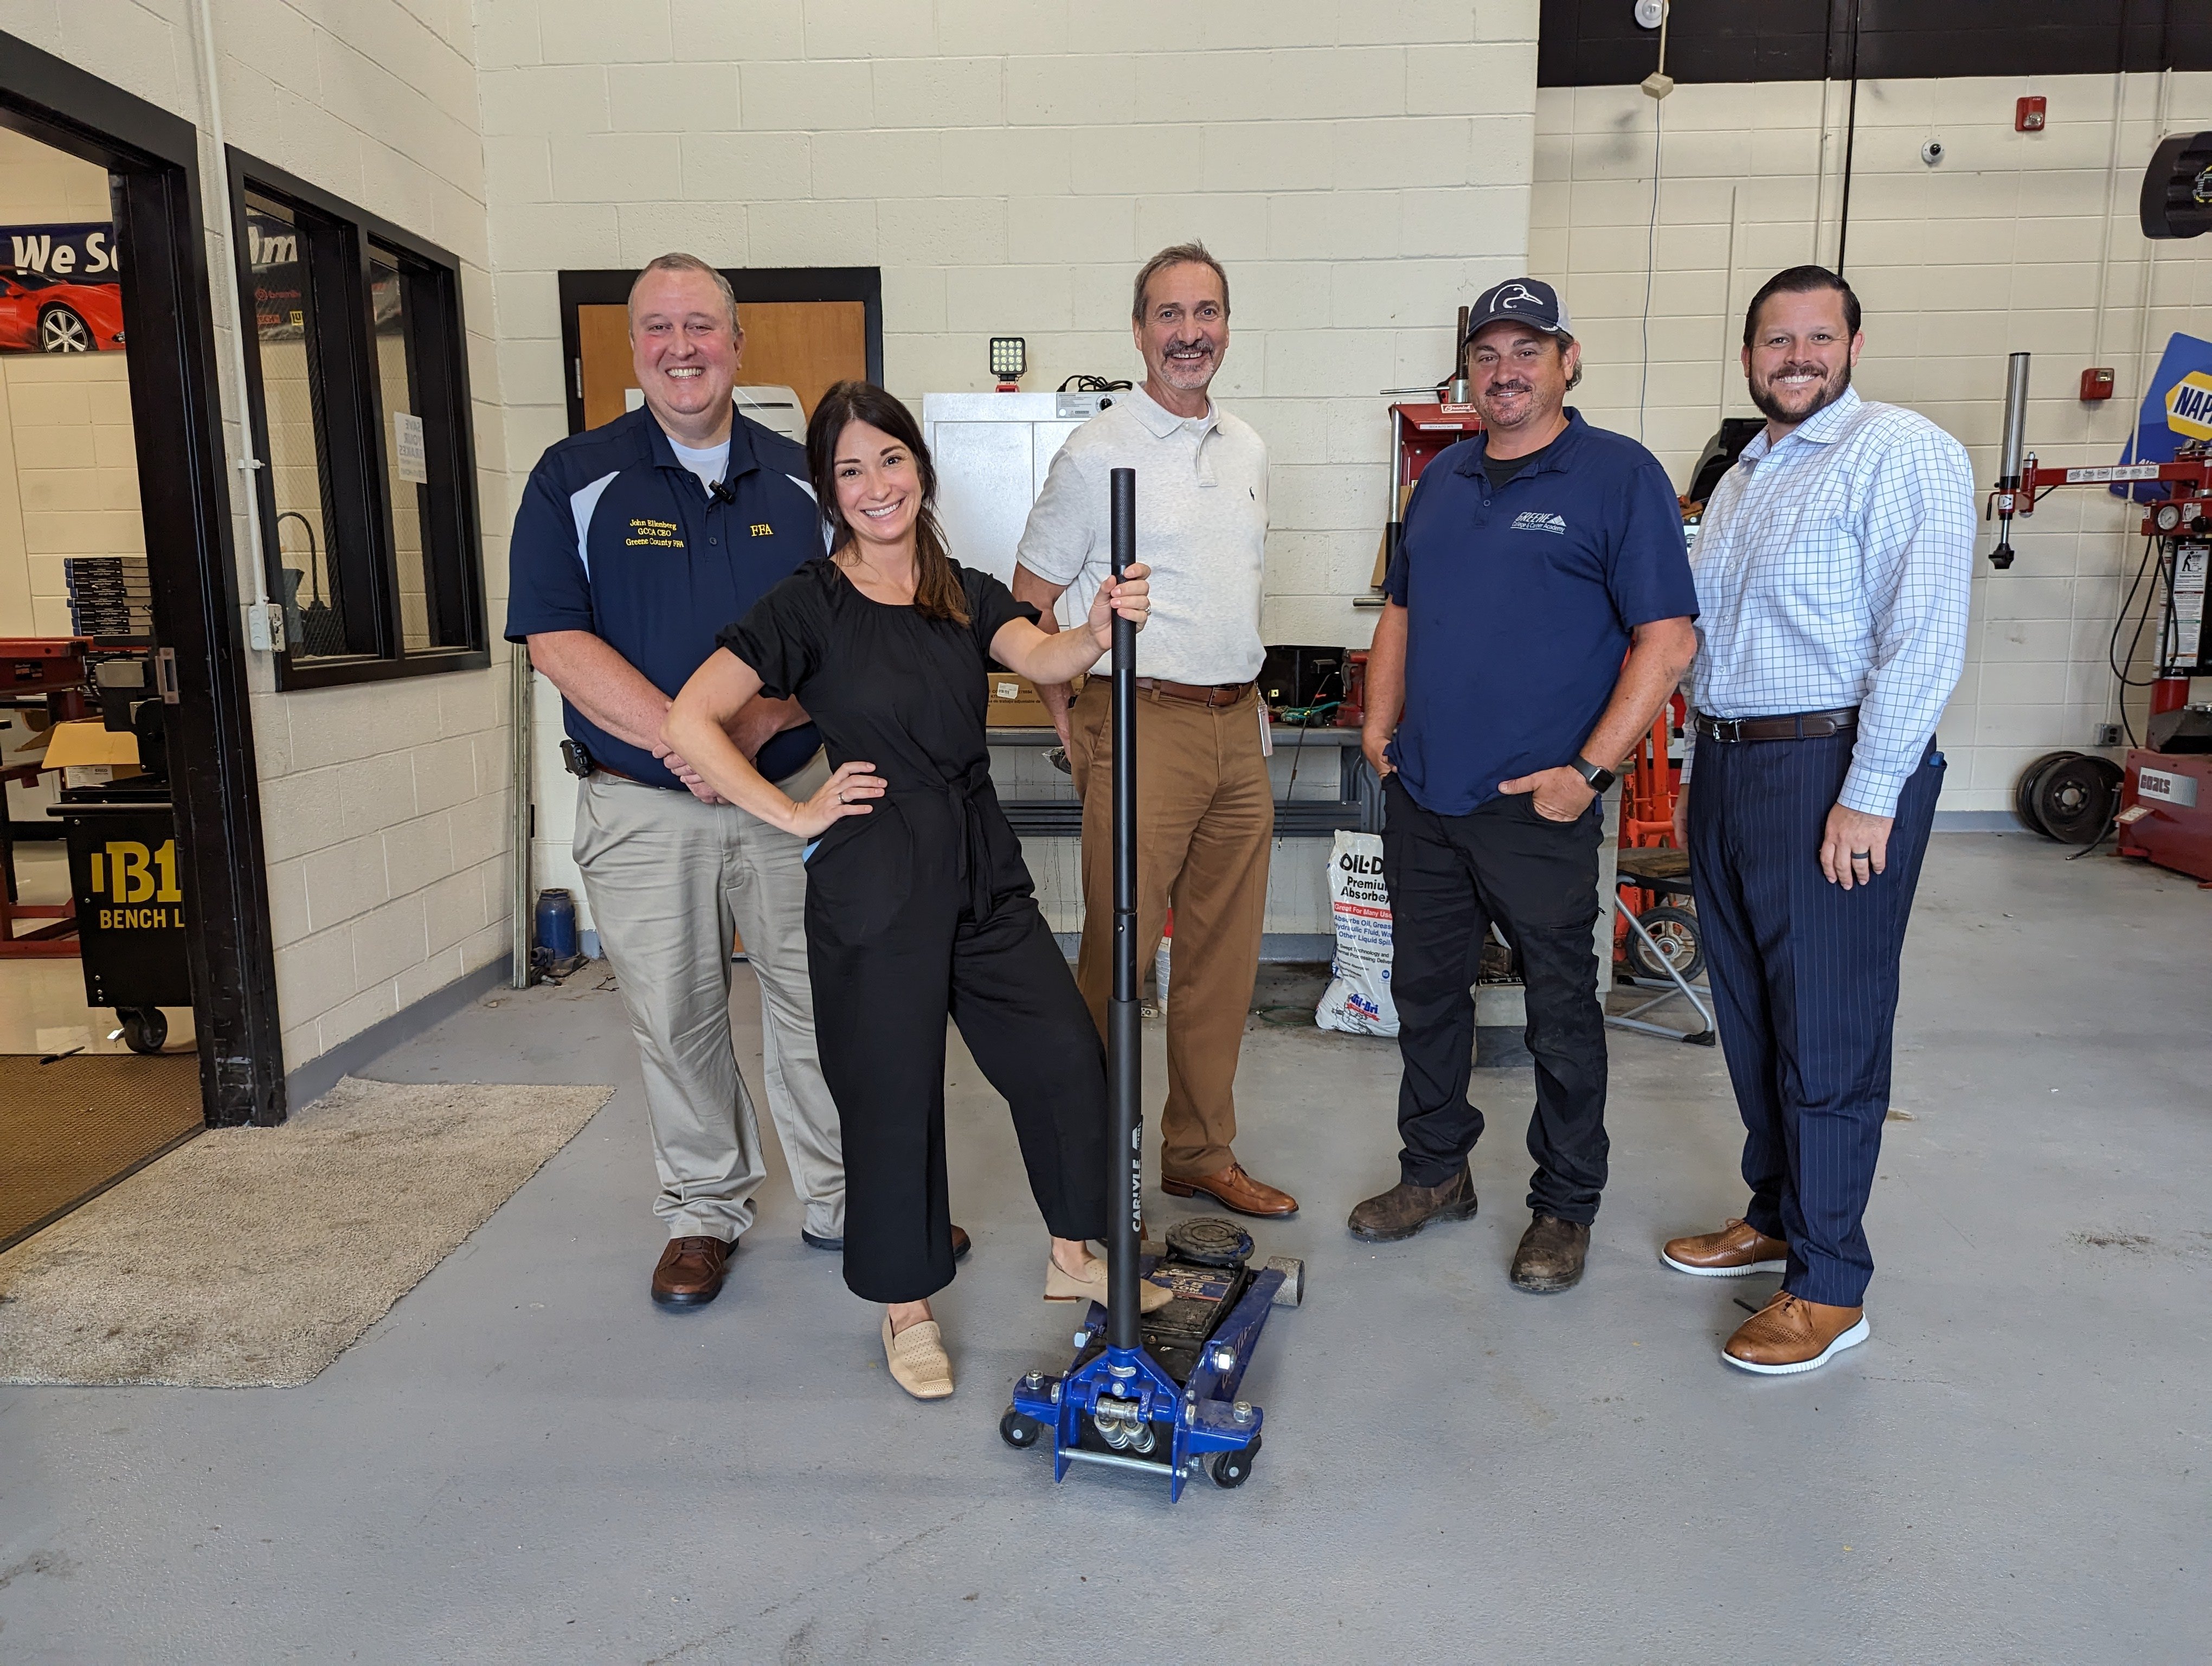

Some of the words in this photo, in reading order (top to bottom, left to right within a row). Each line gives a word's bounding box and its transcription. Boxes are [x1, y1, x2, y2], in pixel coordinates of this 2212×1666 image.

[11, 235, 76, 275] We
[2173, 386, 2212, 425] NAP
[1515, 512, 1554, 523] GREENE
[647, 520, 677, 530] Ellenberg
[750, 523, 774, 536] FFA
[1543, 523, 1565, 533] Academy
[649, 537, 672, 547] County
[1335, 904, 1352, 912] Great
[1364, 909, 1379, 918] Many
[100, 909, 167, 928] BENCH
[1334, 915, 1360, 925] Absorbs
[1335, 923, 1362, 933] Hydraulic
[1364, 928, 1380, 937] Fluid,
[1339, 931, 1356, 939] Other
[1358, 934, 1378, 943] Liquid
[1350, 952, 1375, 963] Processing
